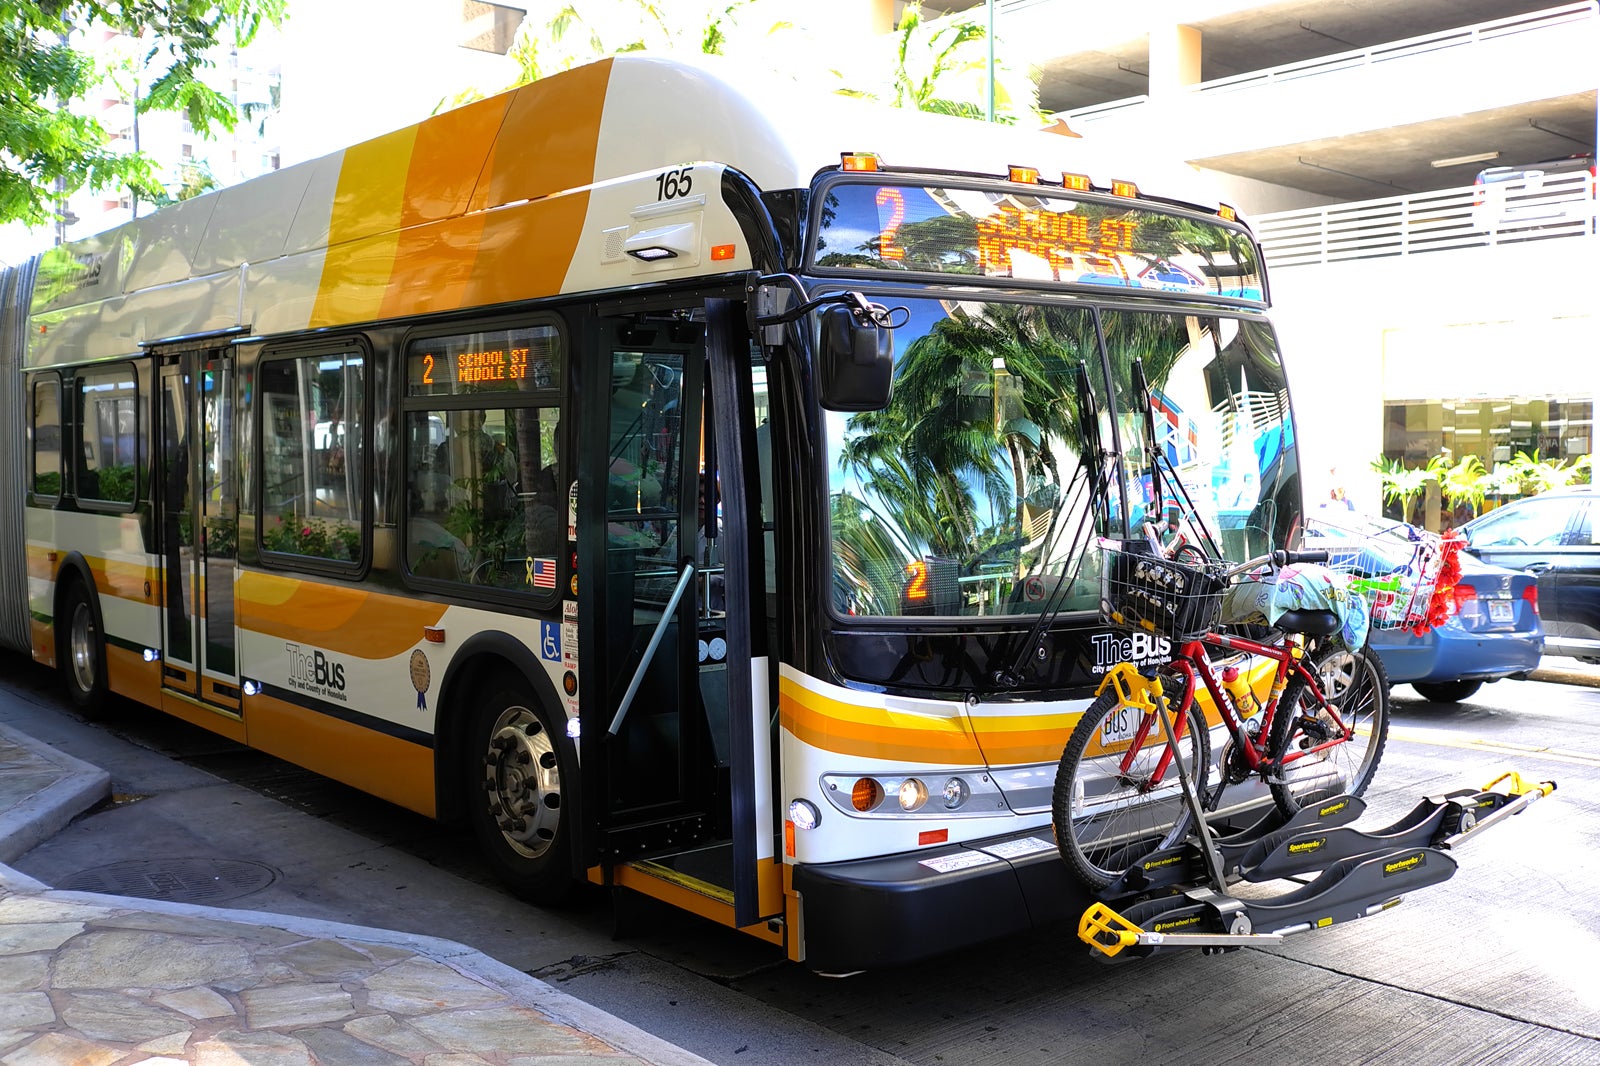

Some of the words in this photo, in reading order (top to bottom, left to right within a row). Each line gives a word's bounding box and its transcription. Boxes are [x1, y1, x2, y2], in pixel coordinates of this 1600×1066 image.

[655, 166, 694, 202] 165
[875, 186, 905, 261] 2
[977, 206, 1094, 245] SCHOOL
[1100, 218, 1138, 249] ST
[422, 353, 434, 385] 2
[458, 351, 506, 367] SCHOOL
[511, 348, 529, 364] ST
[458, 365, 505, 382] MIDDLE
[509, 364, 528, 379] ST
[905, 560, 928, 600] 2
[1091, 632, 1172, 665] TheBus
[285, 642, 346, 691] TheBus
[1091, 665, 1105, 675] City
[1105, 663, 1118, 672] an
[1140, 658, 1147, 666] of
[288, 677, 297, 688] City
[298, 681, 306, 690] and
[306, 683, 321, 696] County
[327, 688, 347, 701] Honolulu
[1201, 650, 1242, 728] SCHWINN
[1105, 708, 1128, 735] BUS
[1320, 802, 1345, 816] Sportworks
[1289, 841, 1320, 853] Sportworks
[1385, 857, 1418, 872] Sportworks
